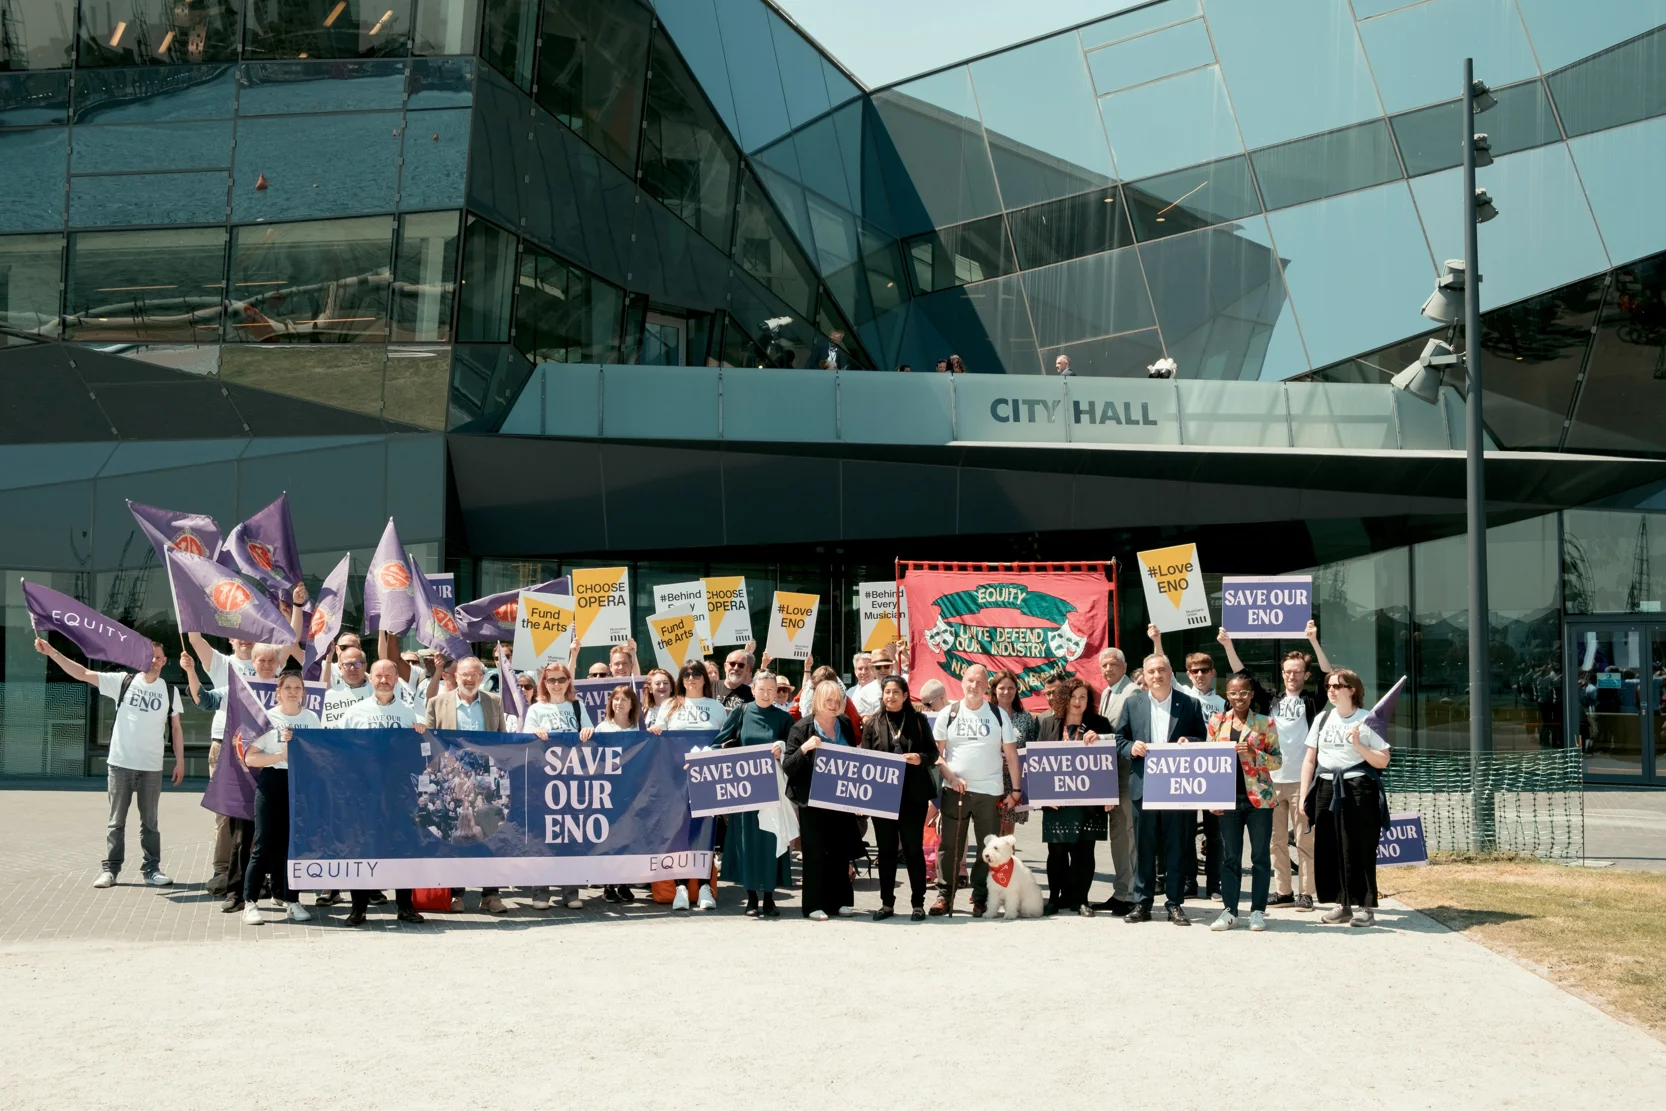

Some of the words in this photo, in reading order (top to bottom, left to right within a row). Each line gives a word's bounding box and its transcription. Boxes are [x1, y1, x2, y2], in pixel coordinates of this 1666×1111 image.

[990, 398, 1061, 423] CITY
[1073, 400, 1158, 425] HALL
[1147, 562, 1193, 578] #Love
[576, 582, 625, 594] CHOOSE
[706, 589, 745, 599] CHOOSE
[1157, 578, 1189, 594] ENO
[577, 594, 626, 608] OPERA
[660, 590, 702, 602] #Behind
[977, 588, 1026, 604] EQUITY
[1224, 590, 1267, 606] SAVE
[1270, 589, 1308, 605] OUR
[707, 600, 746, 612] OPERA
[778, 604, 813, 616] #Love
[872, 600, 897, 609] Every
[531, 607, 560, 620] Fund
[1248, 609, 1284, 625] ENO
[52, 610, 127, 641] EQUITY
[522, 618, 540, 629] the
[543, 620, 567, 632] Arts
[661, 619, 685, 636] Fund
[780, 617, 805, 629] ENO
[657, 638, 673, 650] the
[674, 629, 694, 643] Arts
[997, 628, 1044, 642] DEFEND
[956, 637, 983, 652] OUR
[992, 643, 1048, 657] INDUSTRY
[129, 694, 162, 711] ENO
[677, 711, 710, 722] ENO
[956, 723, 990, 737] ENO
[544, 747, 622, 775] SAVE
[1029, 756, 1072, 772] SAVE
[1075, 754, 1113, 771] OUR
[1146, 757, 1190, 774] SAVE
[1193, 756, 1232, 773] OUR
[690, 762, 733, 783] SAVE
[735, 757, 773, 777] OUR
[815, 756, 859, 779] SAVE
[862, 763, 899, 785] OUR
[716, 780, 751, 800] ENO
[836, 780, 873, 801] ENO
[1054, 775, 1090, 791] ENO
[1170, 777, 1207, 794] ENO
[544, 780, 613, 810] OUR
[544, 814, 610, 844] ENO
[1386, 825, 1418, 840] OUR
[293, 861, 379, 878] EQUITY
[650, 853, 708, 871] EQUIT
